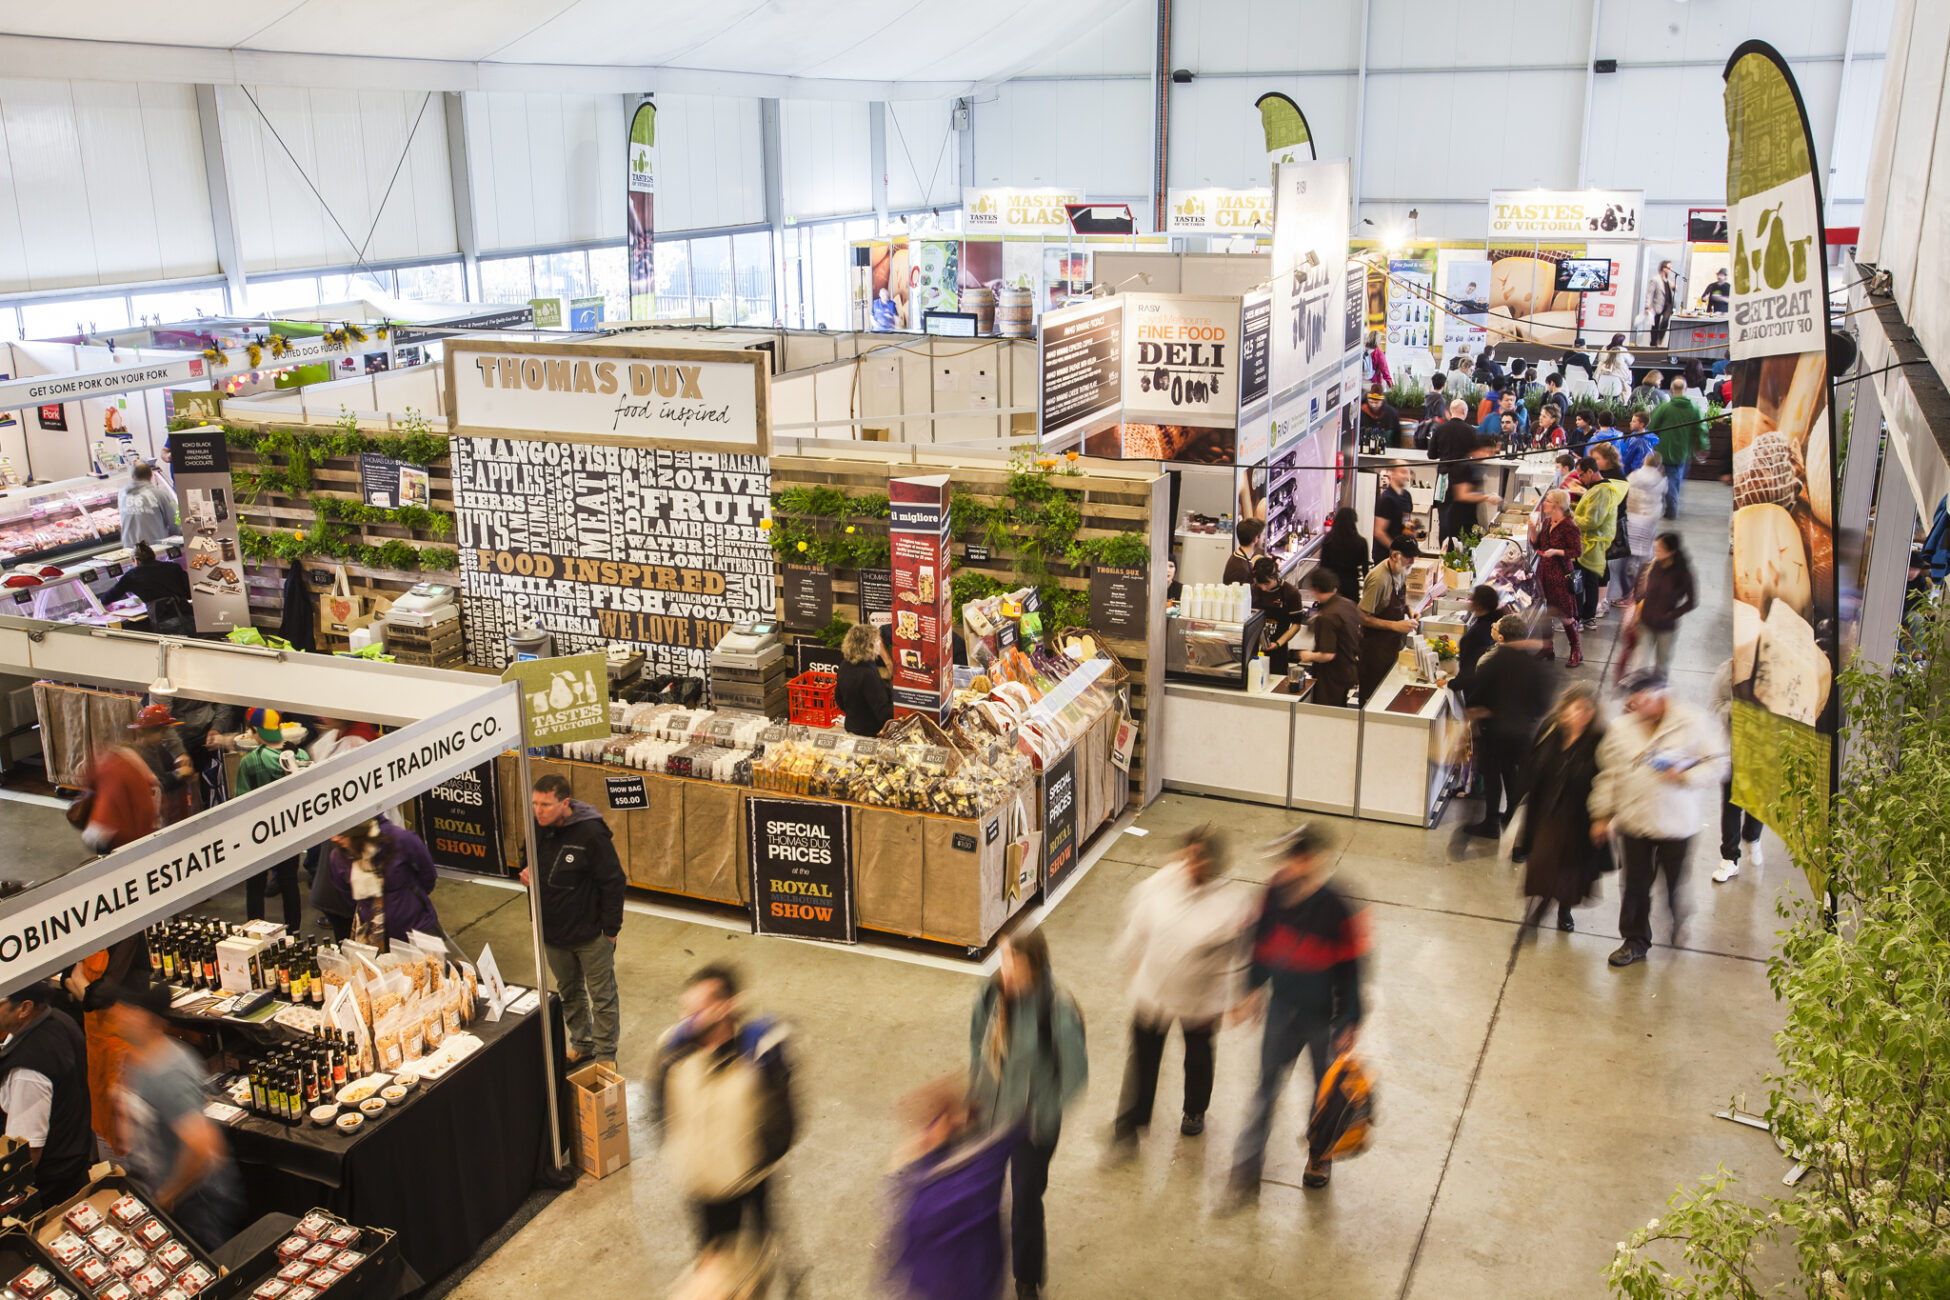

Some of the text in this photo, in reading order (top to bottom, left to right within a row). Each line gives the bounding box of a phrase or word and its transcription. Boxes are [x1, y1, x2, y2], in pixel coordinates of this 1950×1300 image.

[1008, 195, 1078, 207] MASTER
[1216, 196, 1272, 209] MAST
[1007, 208, 1070, 225] CLAS
[1495, 204, 1585, 220] TASTES
[1493, 221, 1582, 231] OF VICTORIA
[1138, 304, 1160, 312] RASV
[1138, 325, 1225, 341] FINE FOOD
[273, 342, 343, 360] SPOTTED DOG FUDGE
[1138, 342, 1224, 368] DELI
[29, 368, 169, 397] GET SOME PORK ON YOUR FORK
[476, 356, 703, 399] THOMAS DUX
[42, 408, 60, 421] Pork
[613, 393, 731, 430] food inspired
[472, 437, 560, 466] MANGO
[572, 443, 621, 474] FISH
[475, 461, 546, 495] APPLES
[560, 443, 577, 541] AVOCADO
[620, 447, 642, 533] DIPS
[462, 491, 526, 512] HERBS
[545, 465, 559, 539] CHOCOLATE
[640, 487, 772, 525] FRUIT
[527, 495, 550, 555] PLUMS
[574, 472, 612, 561] MEAT
[608, 474, 626, 562] TRUFFLE
[899, 512, 939, 523] migliore
[508, 512, 530, 552] JAM
[642, 517, 702, 538] LAMB
[551, 540, 579, 557] DIPS
[625, 534, 704, 554] WATER
[724, 546, 773, 560] BANANA
[628, 548, 704, 569] MELON
[705, 555, 754, 573] PLATTERS
[477, 548, 726, 595] FOOD INSPIRED
[863, 572, 888, 581] THOMAS
[469, 571, 502, 600] EGG
[500, 574, 576, 598] MILK
[725, 572, 745, 608] BEAN
[528, 594, 577, 615] FILLET
[575, 581, 591, 617] BEEF
[590, 583, 666, 615] FISH
[665, 591, 702, 604] SPINACH
[701, 595, 726, 607] OIL
[482, 598, 495, 632] MINCE
[667, 602, 761, 623] AVOCADO
[472, 599, 486, 667] GOURMET
[530, 612, 600, 636] PARMESAN
[597, 609, 632, 639] WE
[637, 613, 690, 647] LOVE
[570, 633, 607, 646] SNOW
[492, 638, 506, 669] OIL
[532, 704, 603, 729] TASTES
[534, 717, 604, 737] OF VICTORIA
[465, 782, 482, 792] DUX
[609, 785, 642, 794] SHOW BAG
[1049, 770, 1072, 800] SPECIAL
[431, 787, 483, 806] PRICES
[615, 796, 640, 805] $50.00
[1049, 793, 1072, 824] PRICES
[434, 817, 485, 837] ROYAL
[766, 820, 831, 839] SPECIAL
[0, 878, 140, 963] OBINVALE
[146, 839, 227, 896] ESTATE
[252, 767, 384, 844] OLIVEGROVE
[387, 730, 466, 782] TRADING
[470, 716, 502, 742] CO.
[436, 838, 487, 858] SHOW
[767, 834, 831, 849] THOMAS DUX
[1049, 824, 1072, 855] ROYAL
[768, 845, 832, 865] PRICES
[1049, 844, 1073, 878] SHOW
[792, 867, 798, 875] at
[769, 879, 833, 898] ROYAL
[770, 894, 833, 906] MELBOURNE
[770, 902, 833, 921] SHOW
